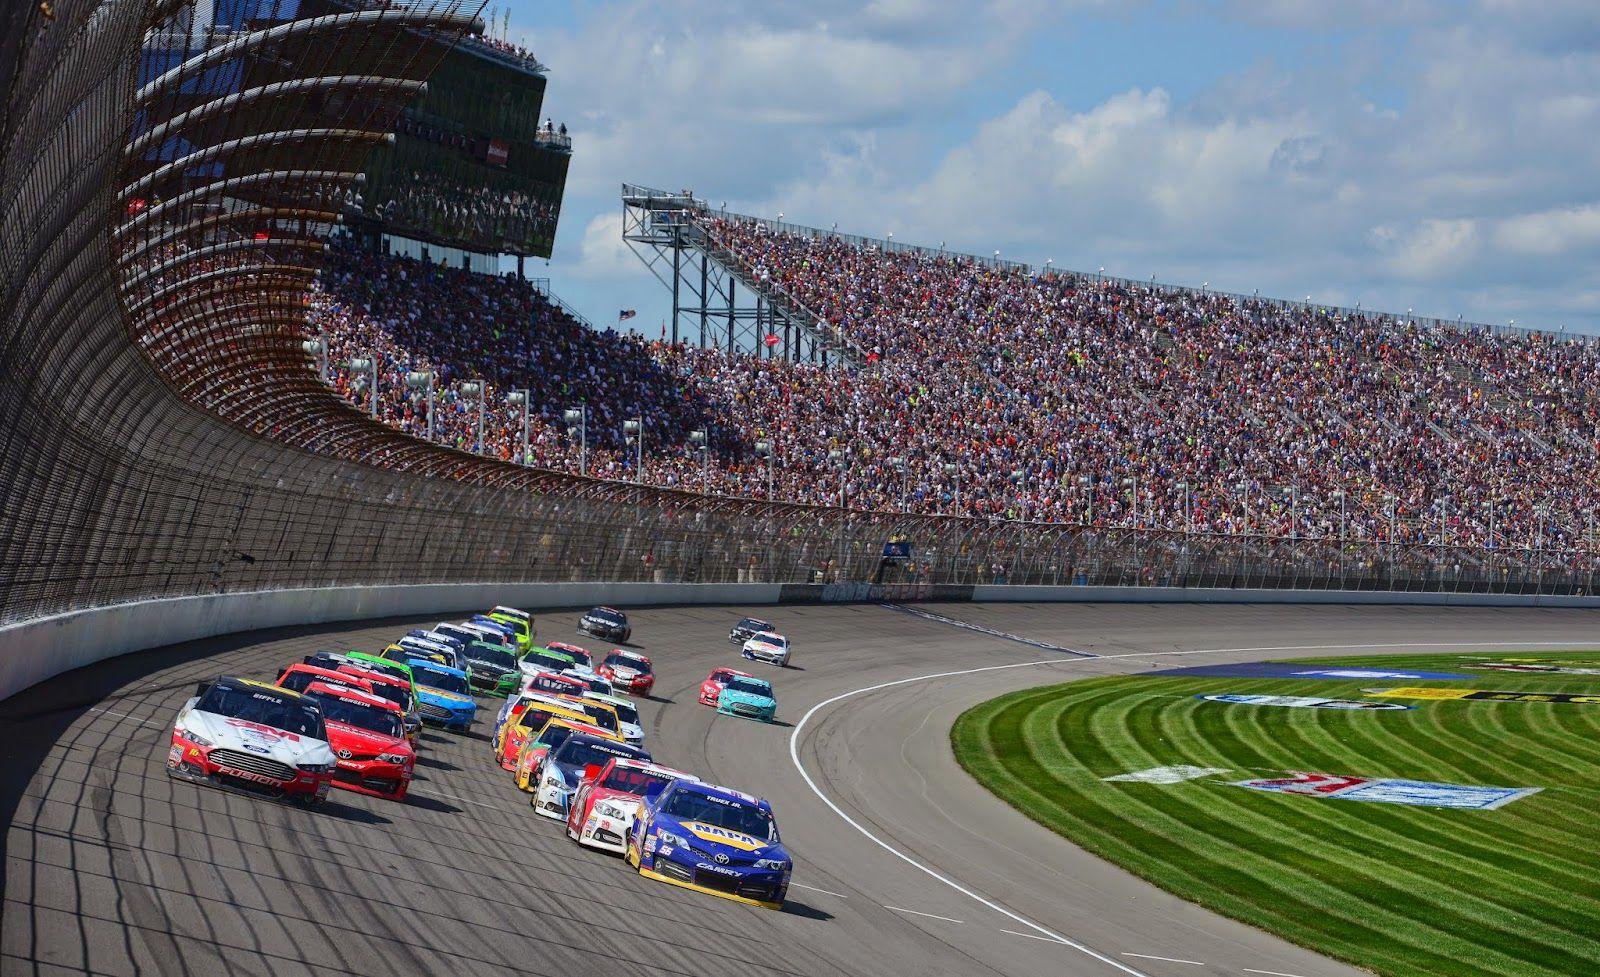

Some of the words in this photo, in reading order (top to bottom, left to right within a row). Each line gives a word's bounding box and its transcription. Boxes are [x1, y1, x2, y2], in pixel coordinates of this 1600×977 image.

[315, 674, 347, 686] STEWART
[253, 692, 283, 705] BIFFLE
[339, 696, 371, 708] KENSETH
[590, 744, 632, 758] KESELOWSKI
[706, 795, 730, 806] TRUEX
[731, 801, 742, 809] JR.
[694, 823, 756, 846] NAPA
[659, 844, 674, 856] 56
[696, 862, 743, 877] CAMRY
